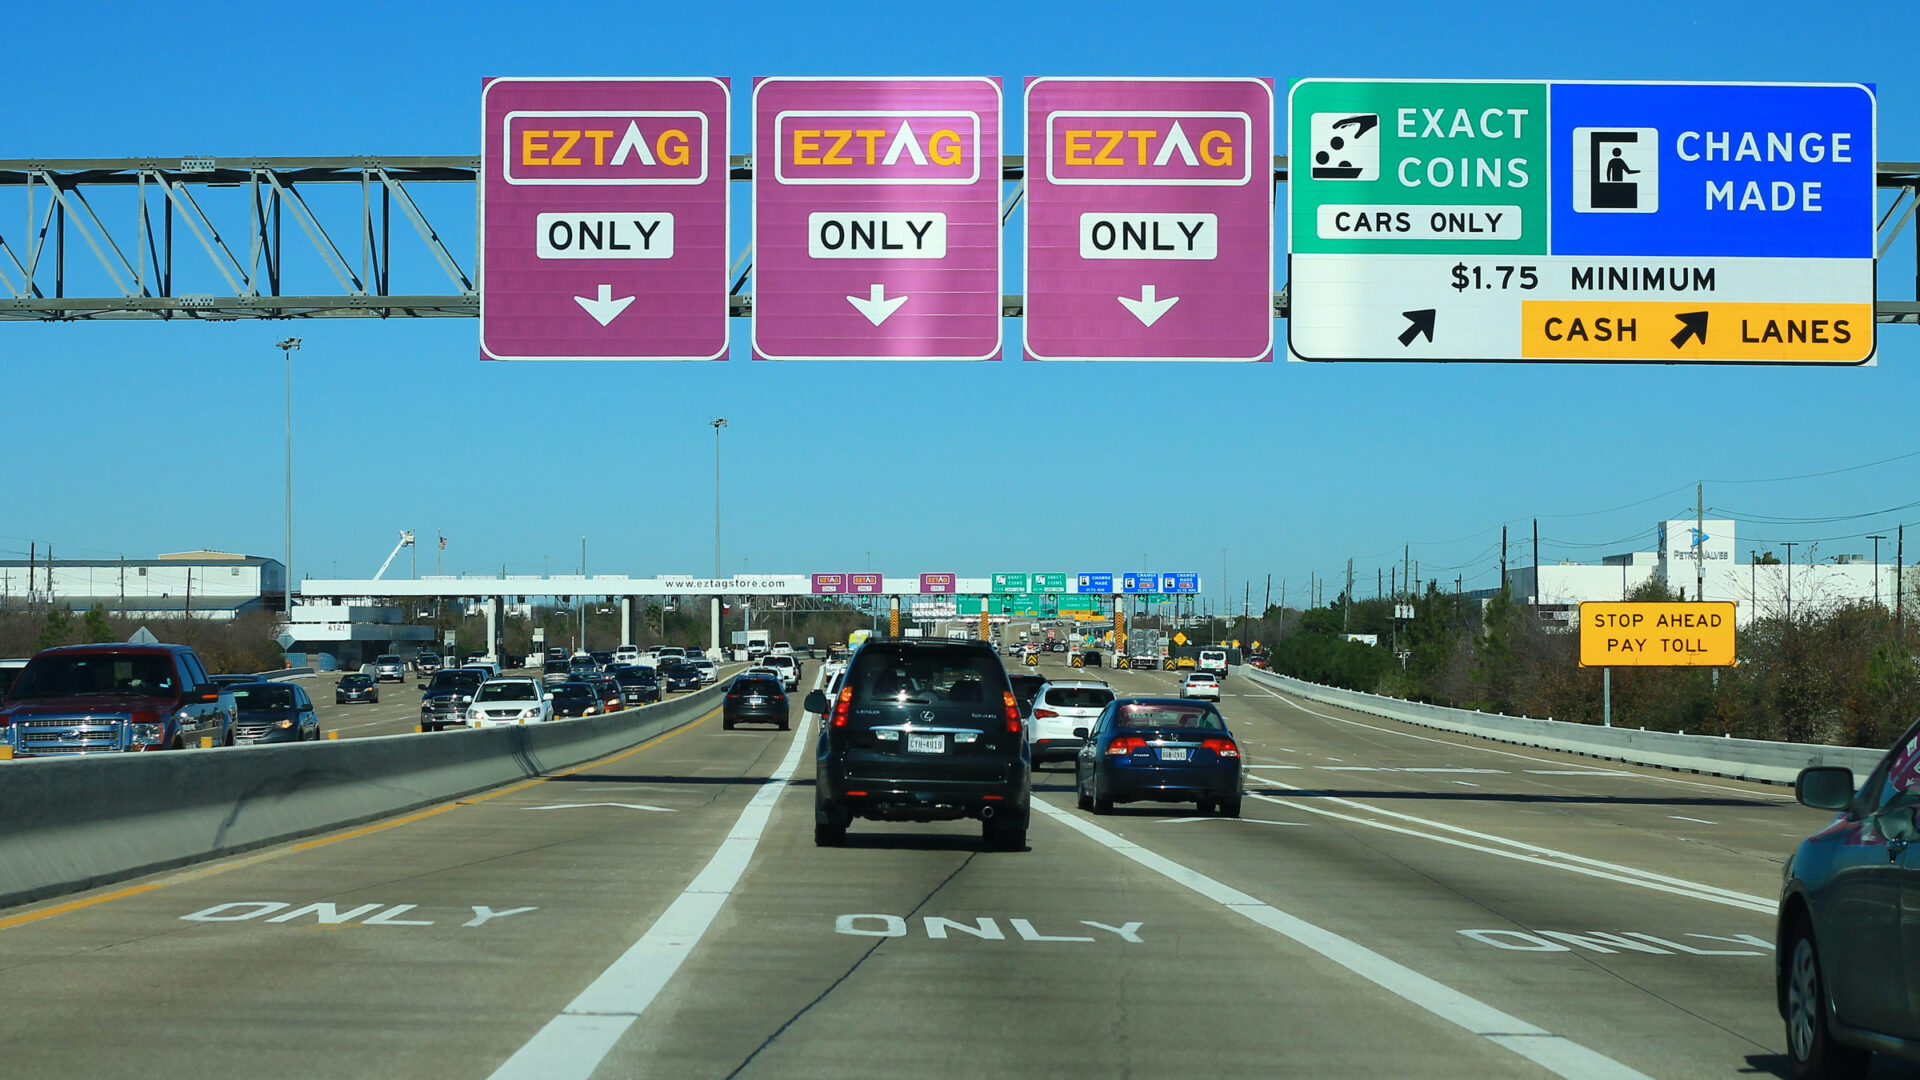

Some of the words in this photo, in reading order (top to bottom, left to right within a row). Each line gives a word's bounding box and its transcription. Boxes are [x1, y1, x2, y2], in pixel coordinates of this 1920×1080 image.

[1397, 108, 1529, 139] EXACT
[522, 120, 690, 167] EZTAG
[793, 119, 963, 167] EZTAG
[1065, 119, 1233, 167] EZTAG
[1676, 131, 1852, 163] CHANGE
[1398, 156, 1529, 188] COINS
[1705, 180, 1823, 212] MADE
[548, 220, 661, 251] ONLY
[820, 220, 933, 251] ONLY
[1091, 220, 1204, 251] ONLY
[1335, 211, 1411, 233] CARS
[1430, 212, 1503, 234] ONLY
[1451, 264, 1539, 292] $1.75
[1571, 266, 1715, 292] MINIMUM
[1544, 317, 1637, 343] CASH
[1741, 319, 1851, 344] LANES
[665, 579, 785, 589] www.eztagstore.com
[1594, 613, 1644, 628] STOP
[1656, 613, 1722, 628] AHEAD
[1607, 638, 1647, 652] PAY
[1660, 638, 1708, 652] TOLL
[179, 901, 538, 928] ONLY
[835, 913, 1145, 944] ONLY
[1455, 929, 1776, 956] ONLY
